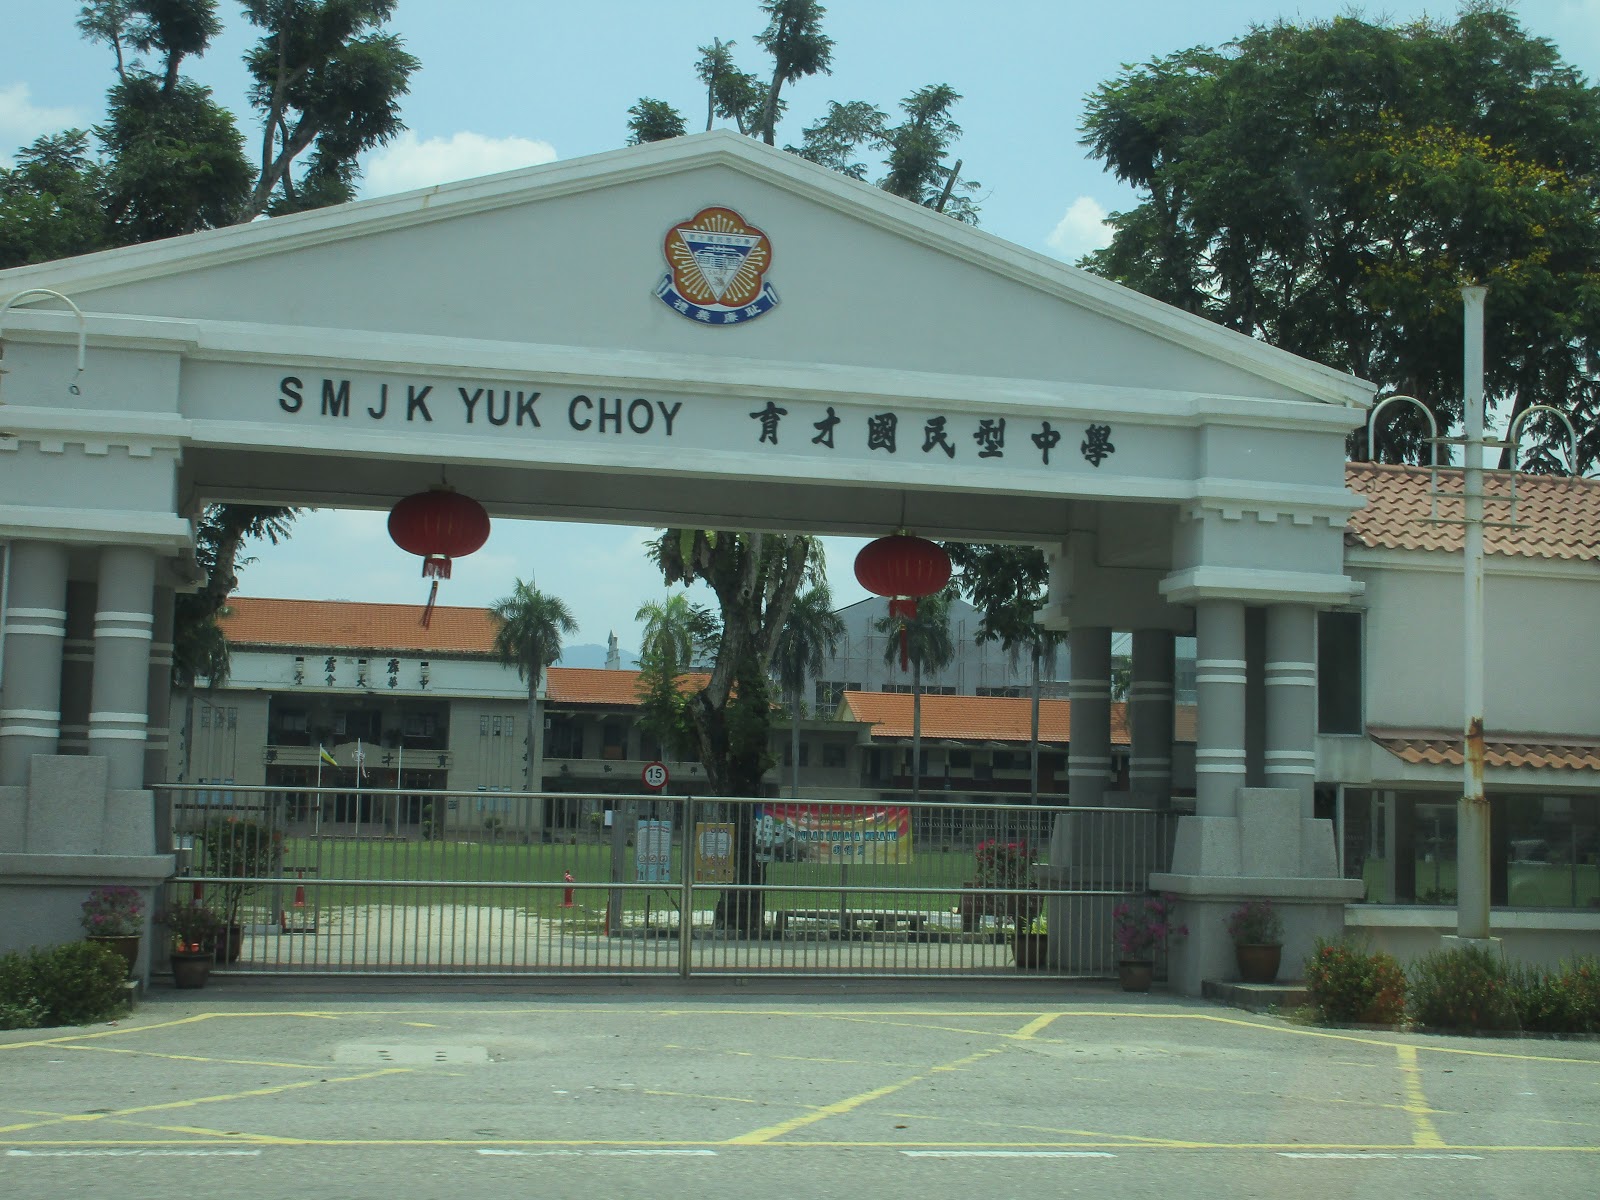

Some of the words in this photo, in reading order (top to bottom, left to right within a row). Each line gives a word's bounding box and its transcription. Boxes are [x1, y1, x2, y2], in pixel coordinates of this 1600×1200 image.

[458, 387, 541, 428] YUK
[568, 394, 682, 437] CHOY
[749, 401, 1116, 468] 育才國民型中學
[648, 768, 662, 779] 15
